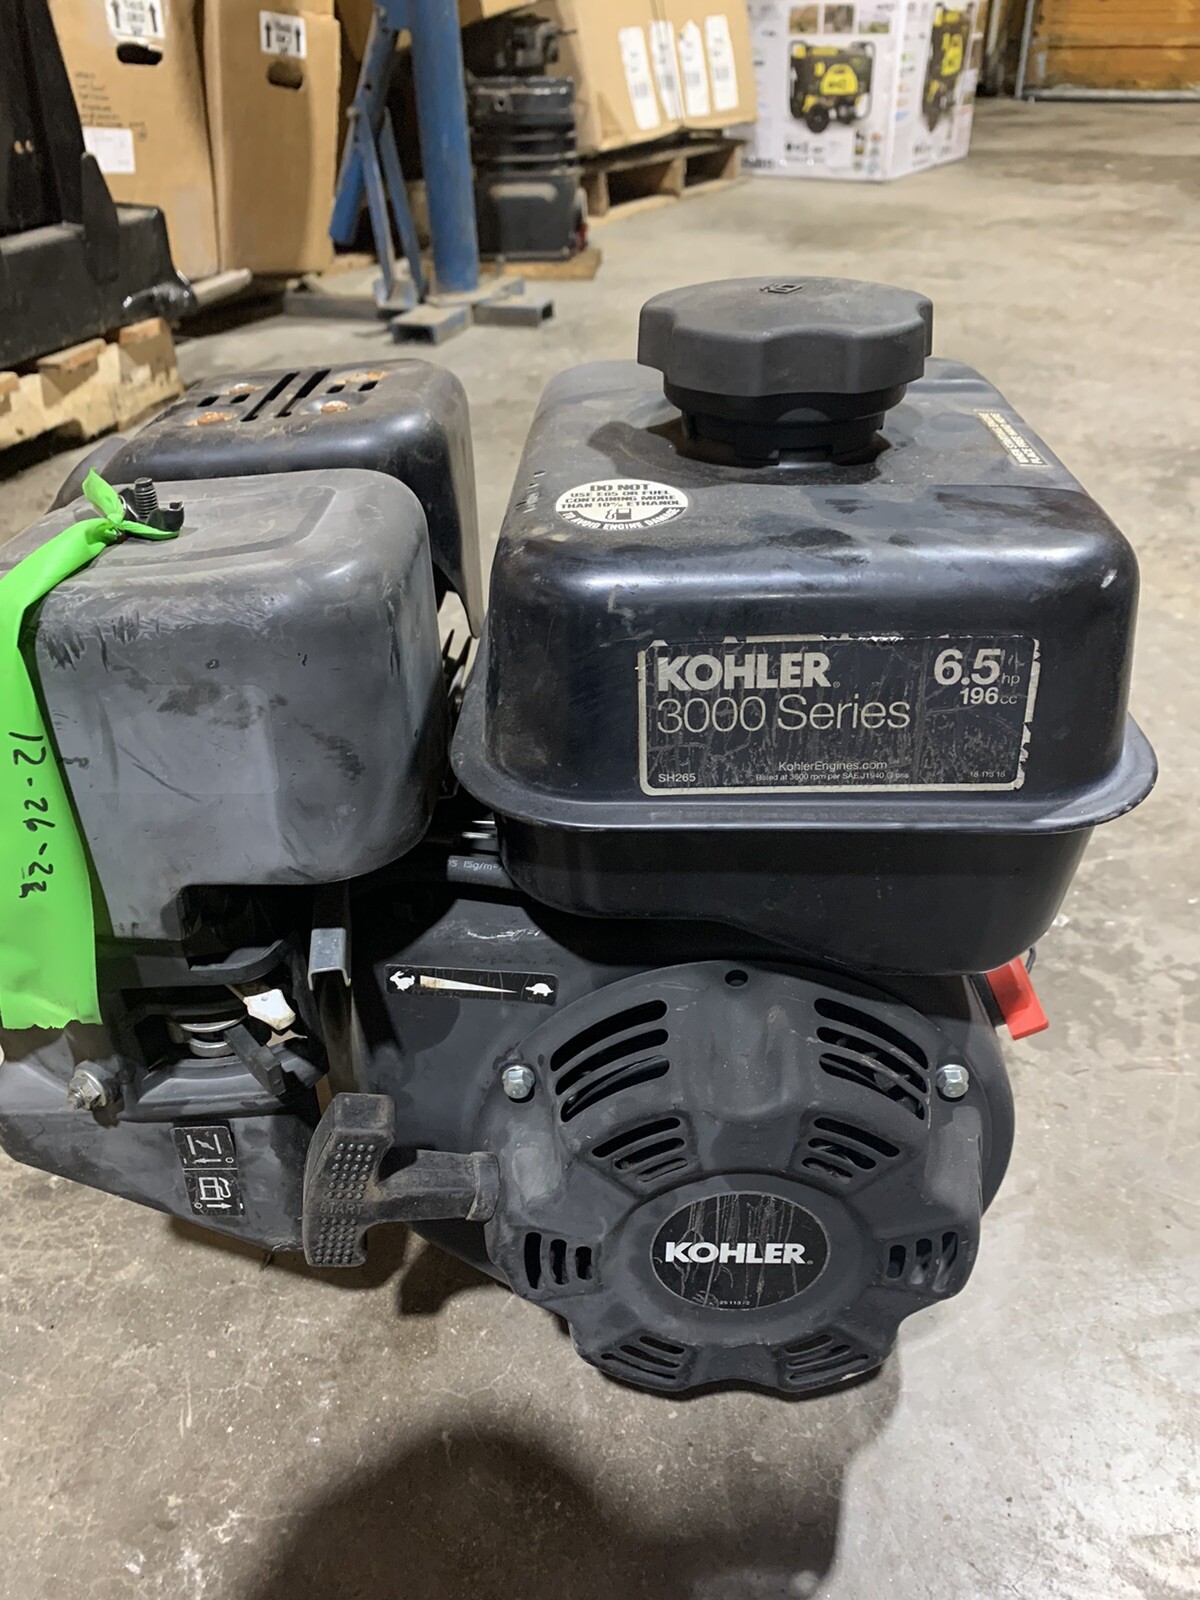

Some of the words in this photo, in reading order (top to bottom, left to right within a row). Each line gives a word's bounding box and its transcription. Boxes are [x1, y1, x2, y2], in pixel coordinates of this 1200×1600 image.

[602, 521, 644, 530] ENGINE
[657, 652, 831, 692] KOHLER
[933, 648, 1001, 686] 6.5
[960, 686, 999, 705] 196
[657, 696, 767, 734] 3000
[777, 693, 911, 731] Series
[778, 761, 888, 773] KohlerEngines.com
[658, 772, 697, 783] SH265
[810, 773, 827, 782] rpm
[664, 1241, 806, 1265] KOHLER
